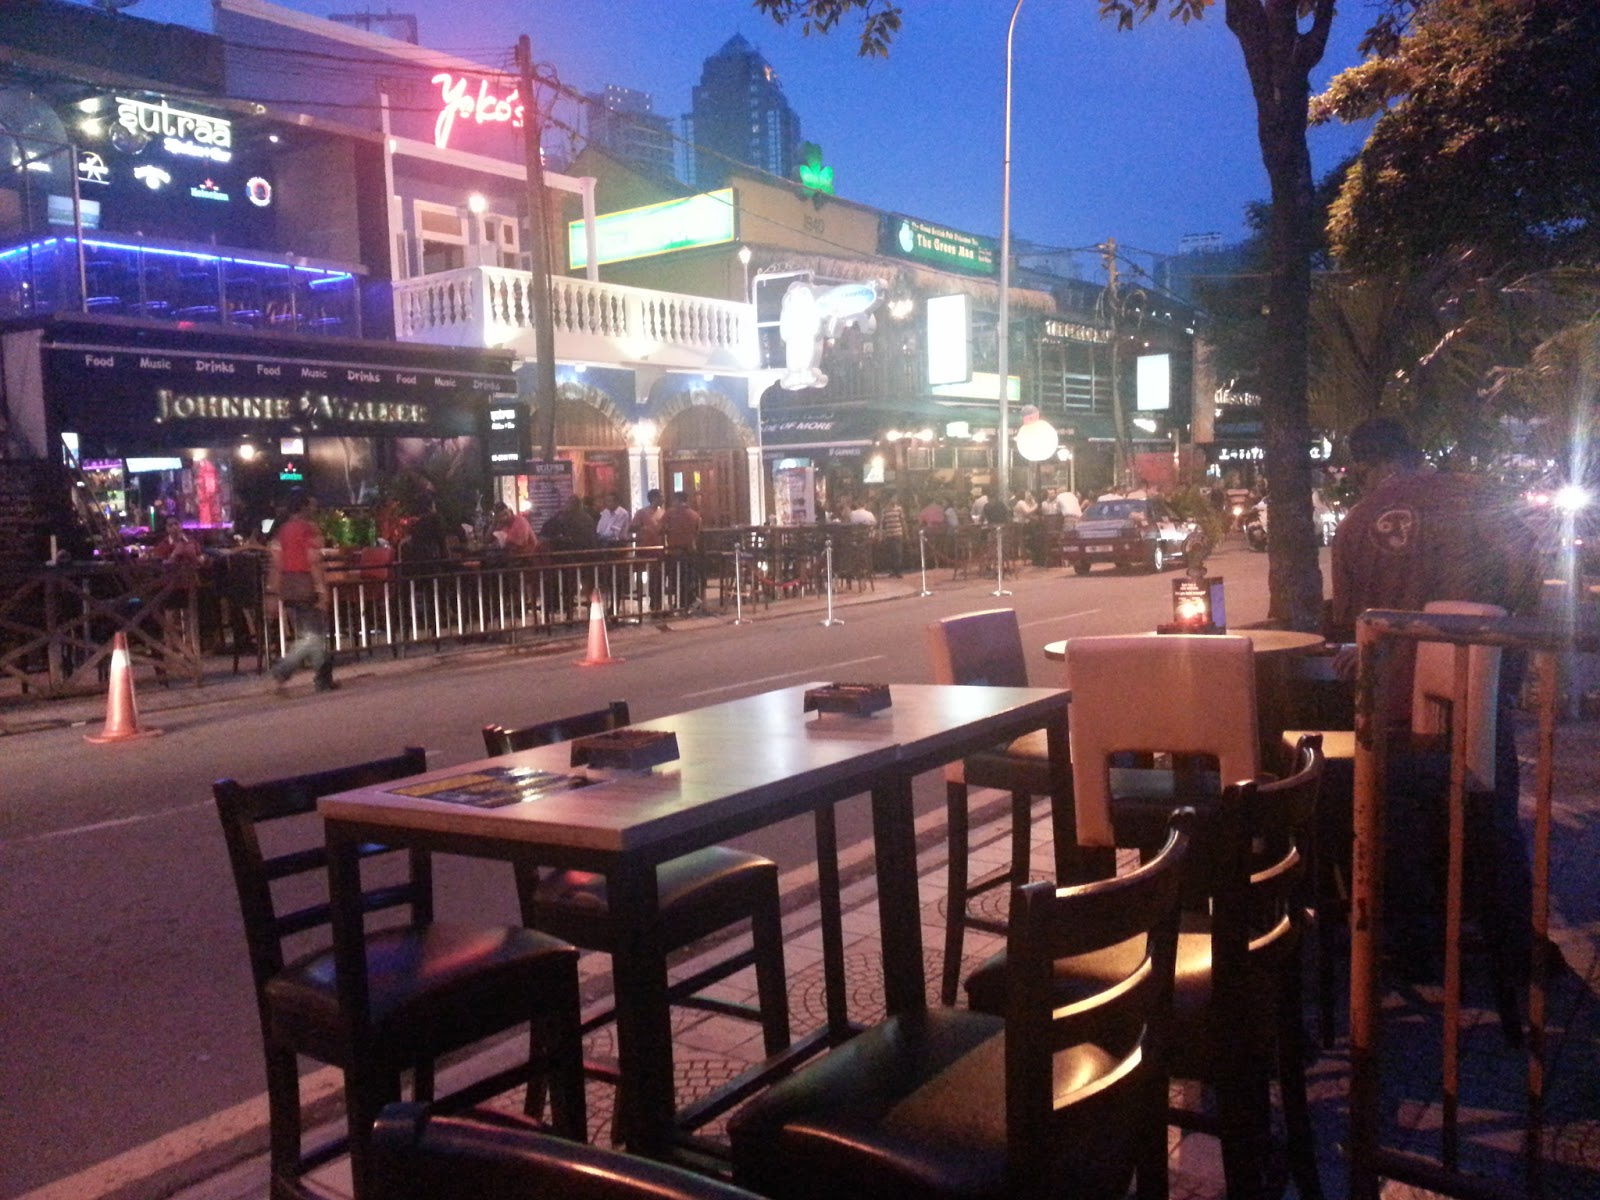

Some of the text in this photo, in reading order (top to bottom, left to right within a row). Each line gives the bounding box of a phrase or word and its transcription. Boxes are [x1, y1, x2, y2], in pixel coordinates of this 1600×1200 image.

[917, 232, 932, 249] The
[934, 237, 957, 255] Green
[958, 245, 975, 259] Man
[85, 353, 502, 391] Food Music Drinks Food Music Drinks Food Music Drinks
[796, 421, 834, 431] MORE
